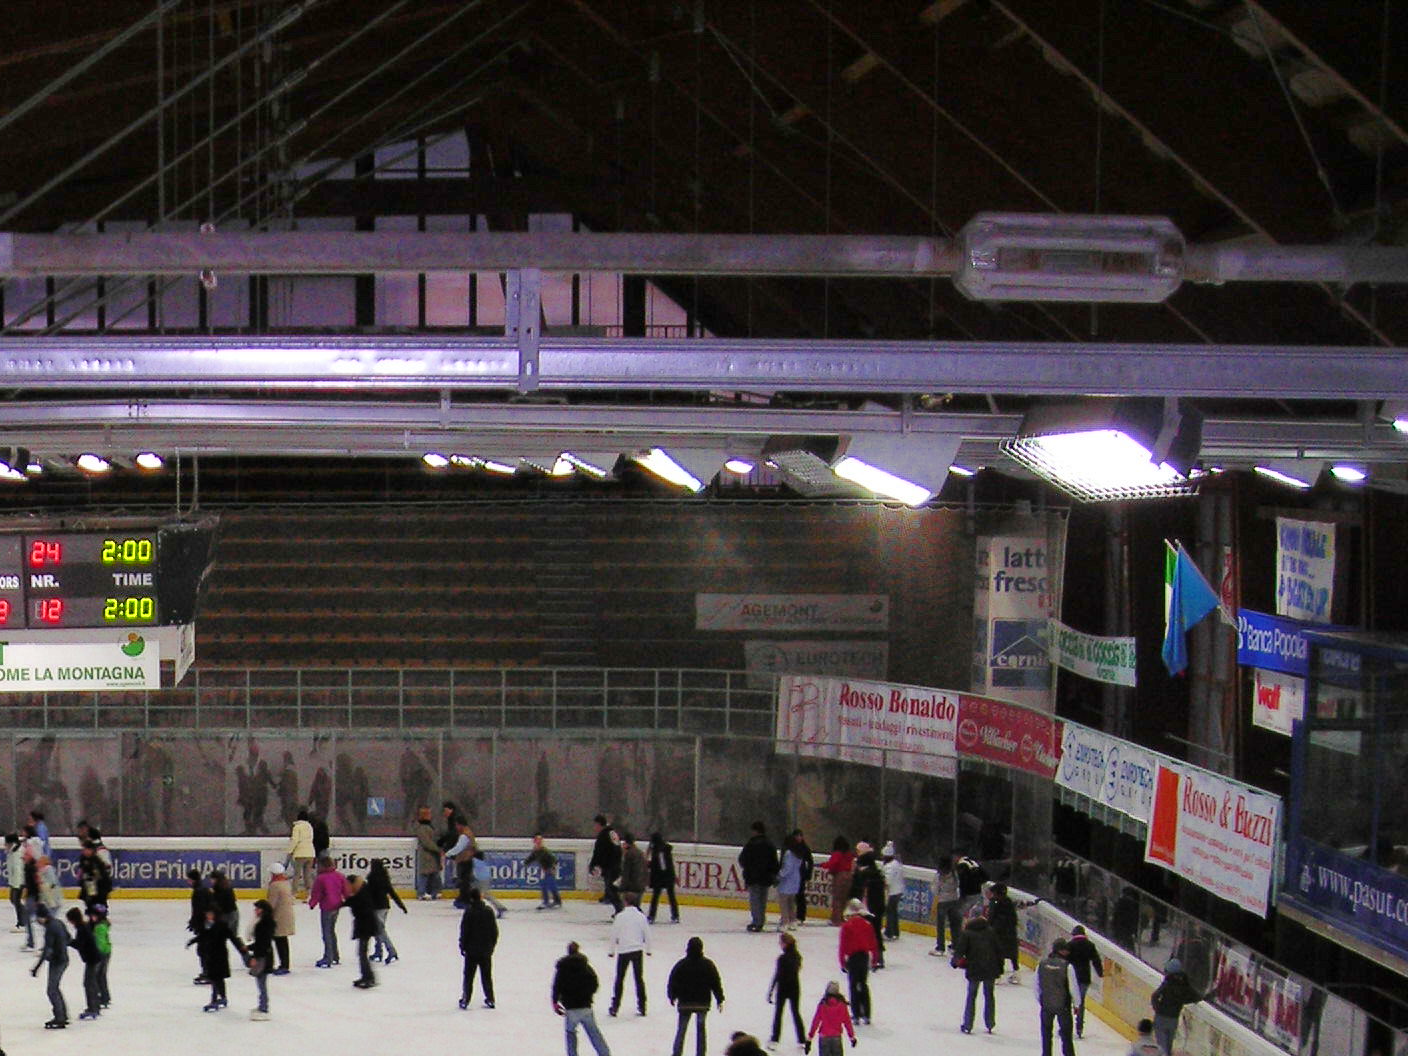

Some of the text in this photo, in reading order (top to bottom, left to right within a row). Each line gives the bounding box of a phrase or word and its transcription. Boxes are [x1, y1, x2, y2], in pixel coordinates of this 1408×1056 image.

[31, 541, 60, 562] 24
[102, 540, 152, 561] 2:00
[30, 573, 61, 588] NR.
[112, 572, 153, 586] TIME
[41, 598, 63, 621] 12
[104, 597, 153, 619] 2:00
[1247, 624, 1273, 653] Banca
[1274, 628, 1308, 661] Popola
[34, 668, 54, 681] LA
[57, 666, 146, 681] MONTAGNA
[839, 683, 884, 712] Rosso
[1182, 775, 1275, 847] Rosso & Buzzi
